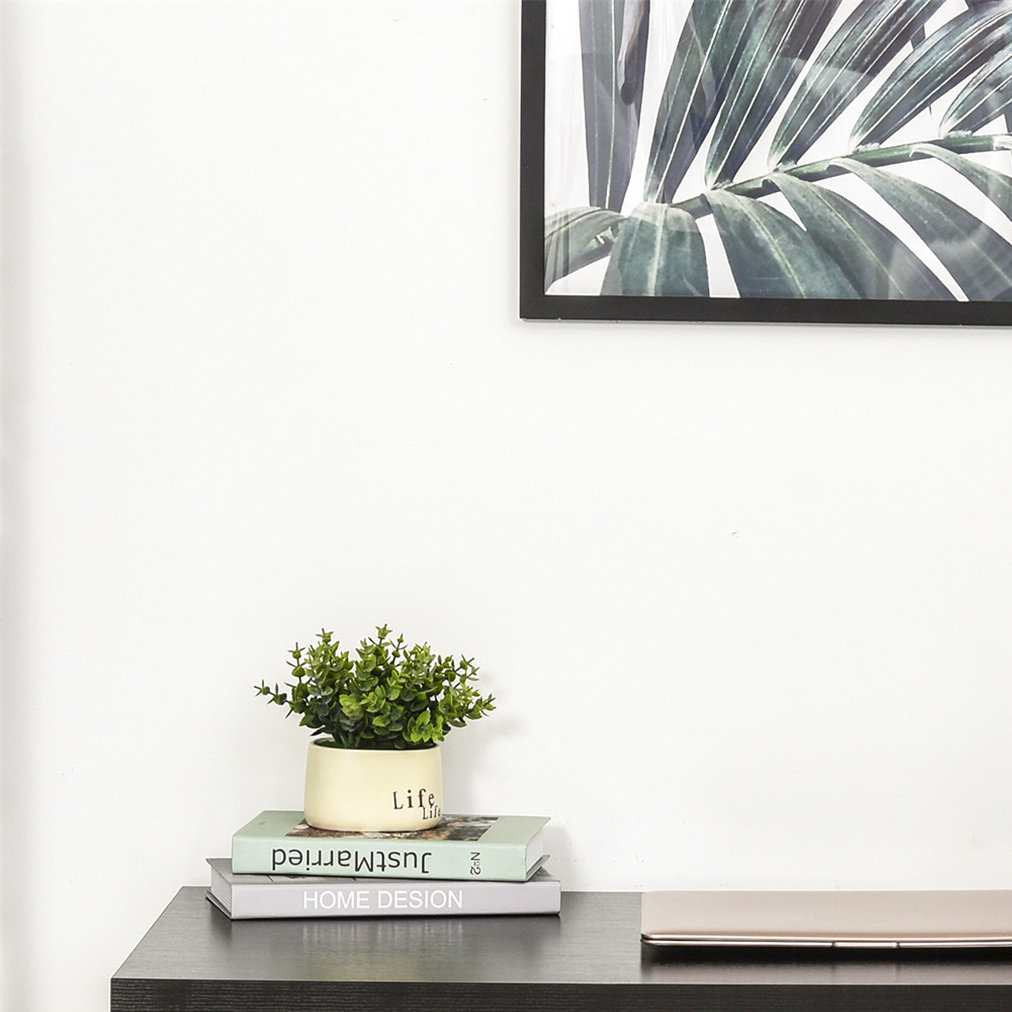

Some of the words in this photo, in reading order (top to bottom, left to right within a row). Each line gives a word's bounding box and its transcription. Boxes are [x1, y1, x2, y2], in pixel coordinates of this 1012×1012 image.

[393, 788, 435, 810] Life
[272, 849, 432, 873] JustMarried
[303, 890, 370, 909] HOME
[377, 889, 463, 908] DESION
